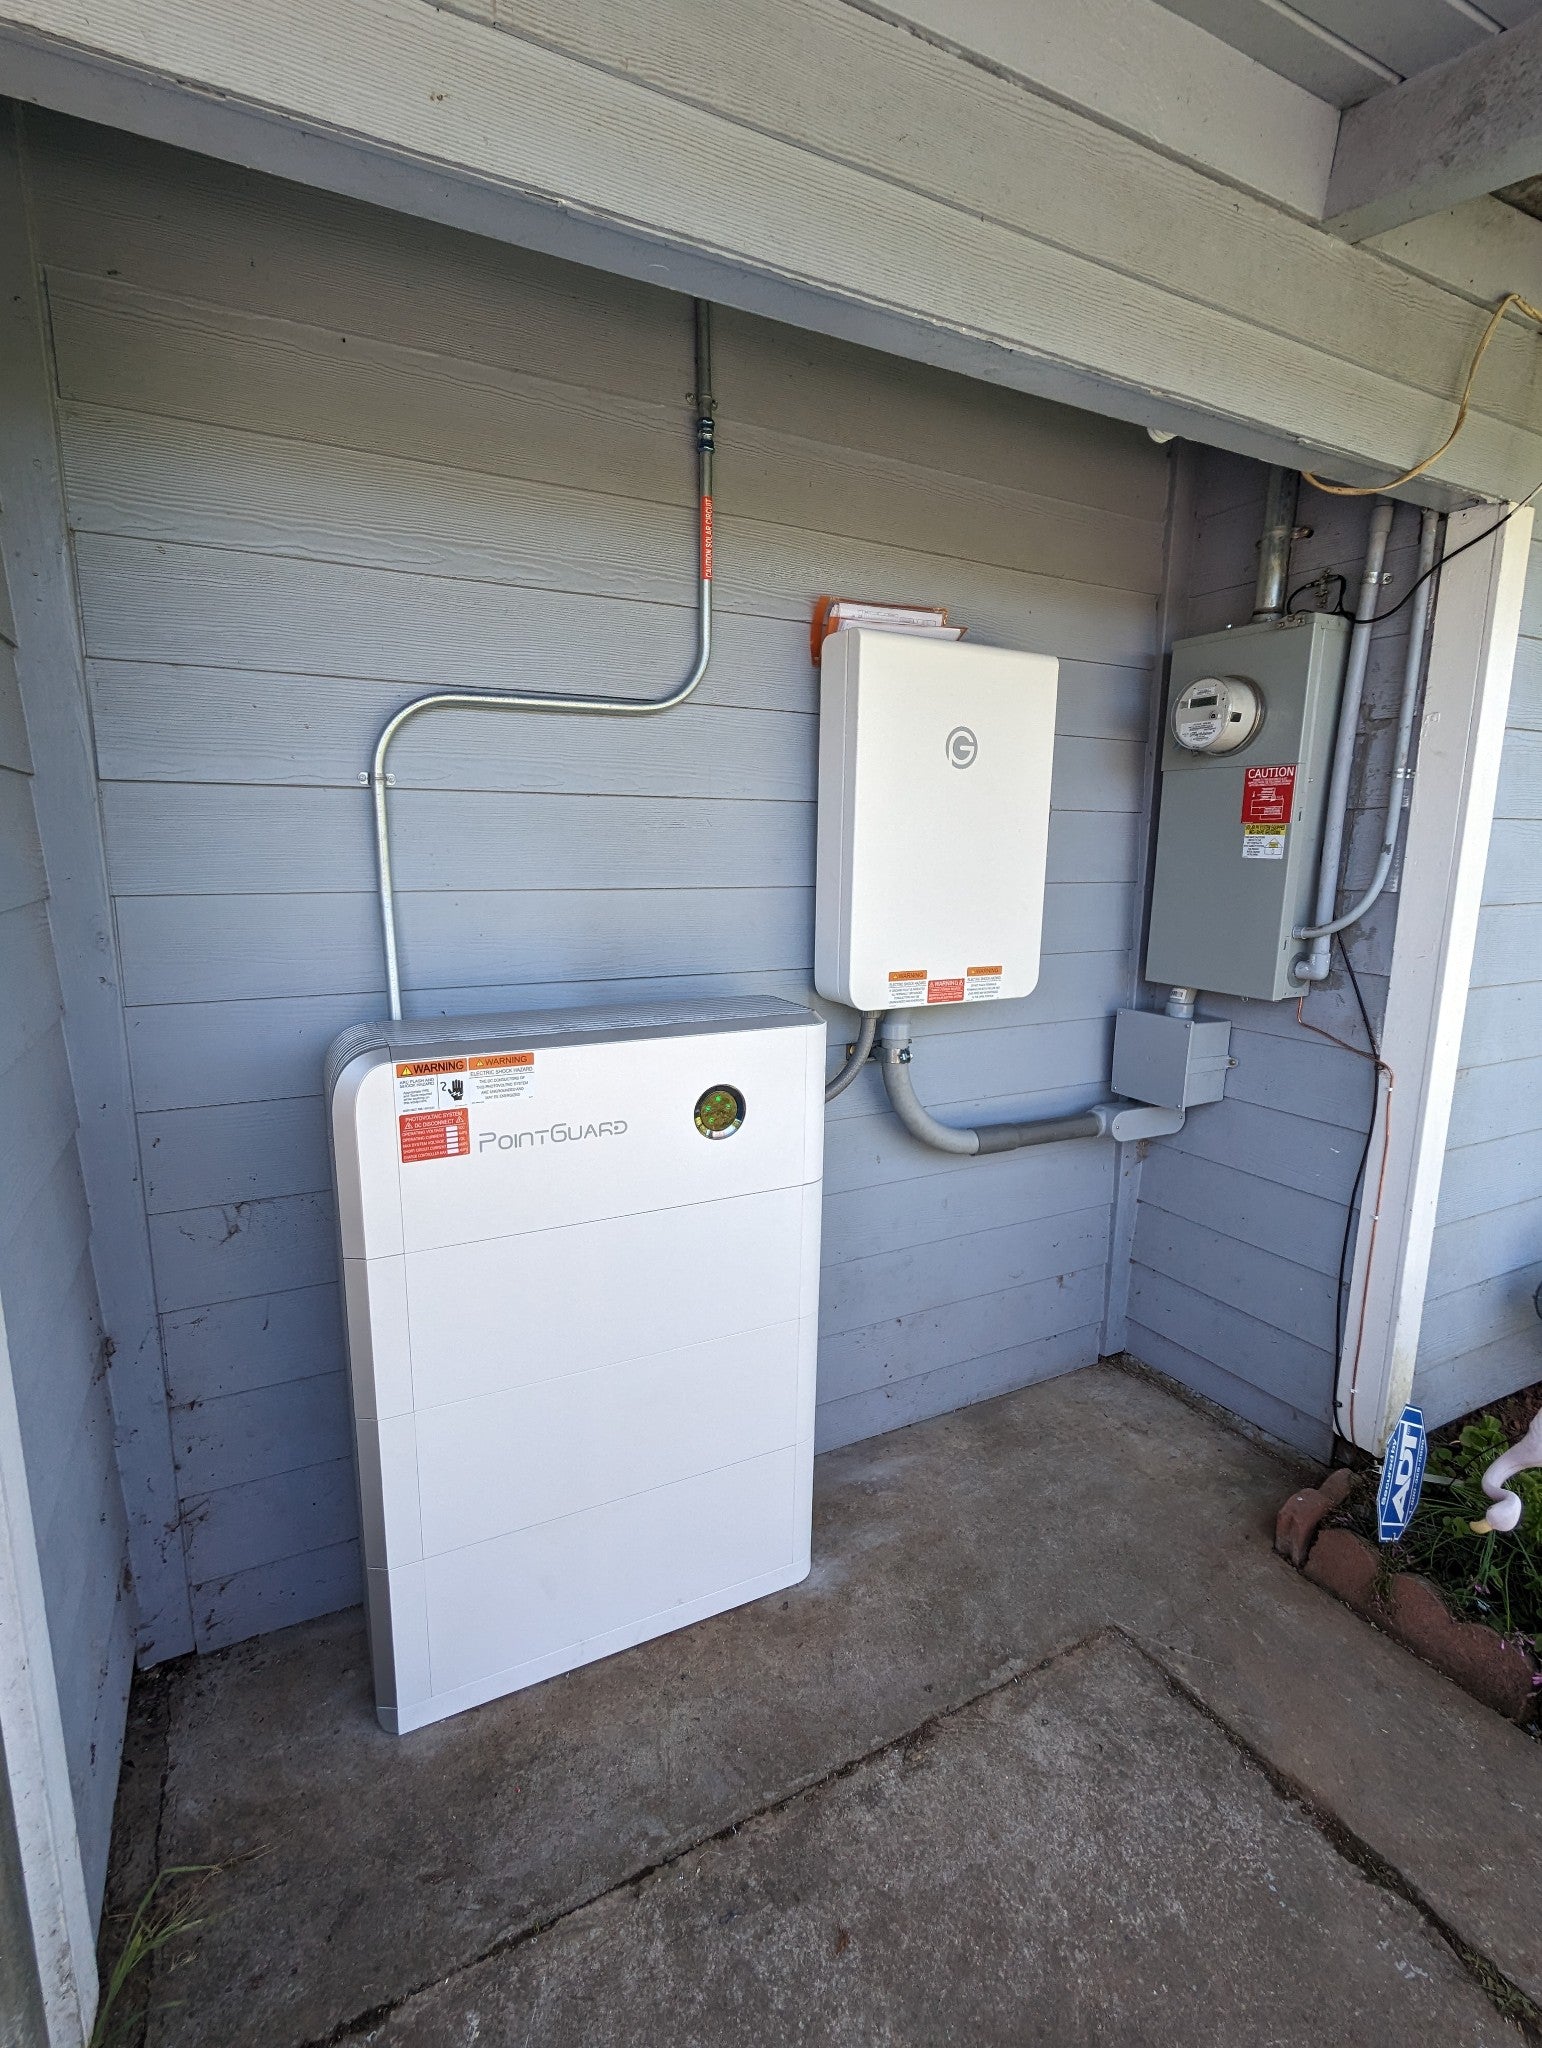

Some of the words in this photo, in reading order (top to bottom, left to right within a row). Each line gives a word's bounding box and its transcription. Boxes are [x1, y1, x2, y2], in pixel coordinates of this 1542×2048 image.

[705, 497, 713, 525] CIRCUIT
[705, 526, 713, 548] SOLAR
[705, 549, 713, 578] CAUTION
[1248, 766, 1295, 779] CAUTION
[899, 971, 924, 979] WARNING
[413, 1060, 464, 1074] WARNING
[485, 1055, 528, 1066] WARNING
[405, 1113, 443, 1122] PHOTOVOLTAIC
[443, 1110, 463, 1118] SYSTEM
[1380, 1455, 1396, 1506] Secured
[1390, 1438, 1397, 1454] by
[1391, 1421, 1419, 1523] ADT
